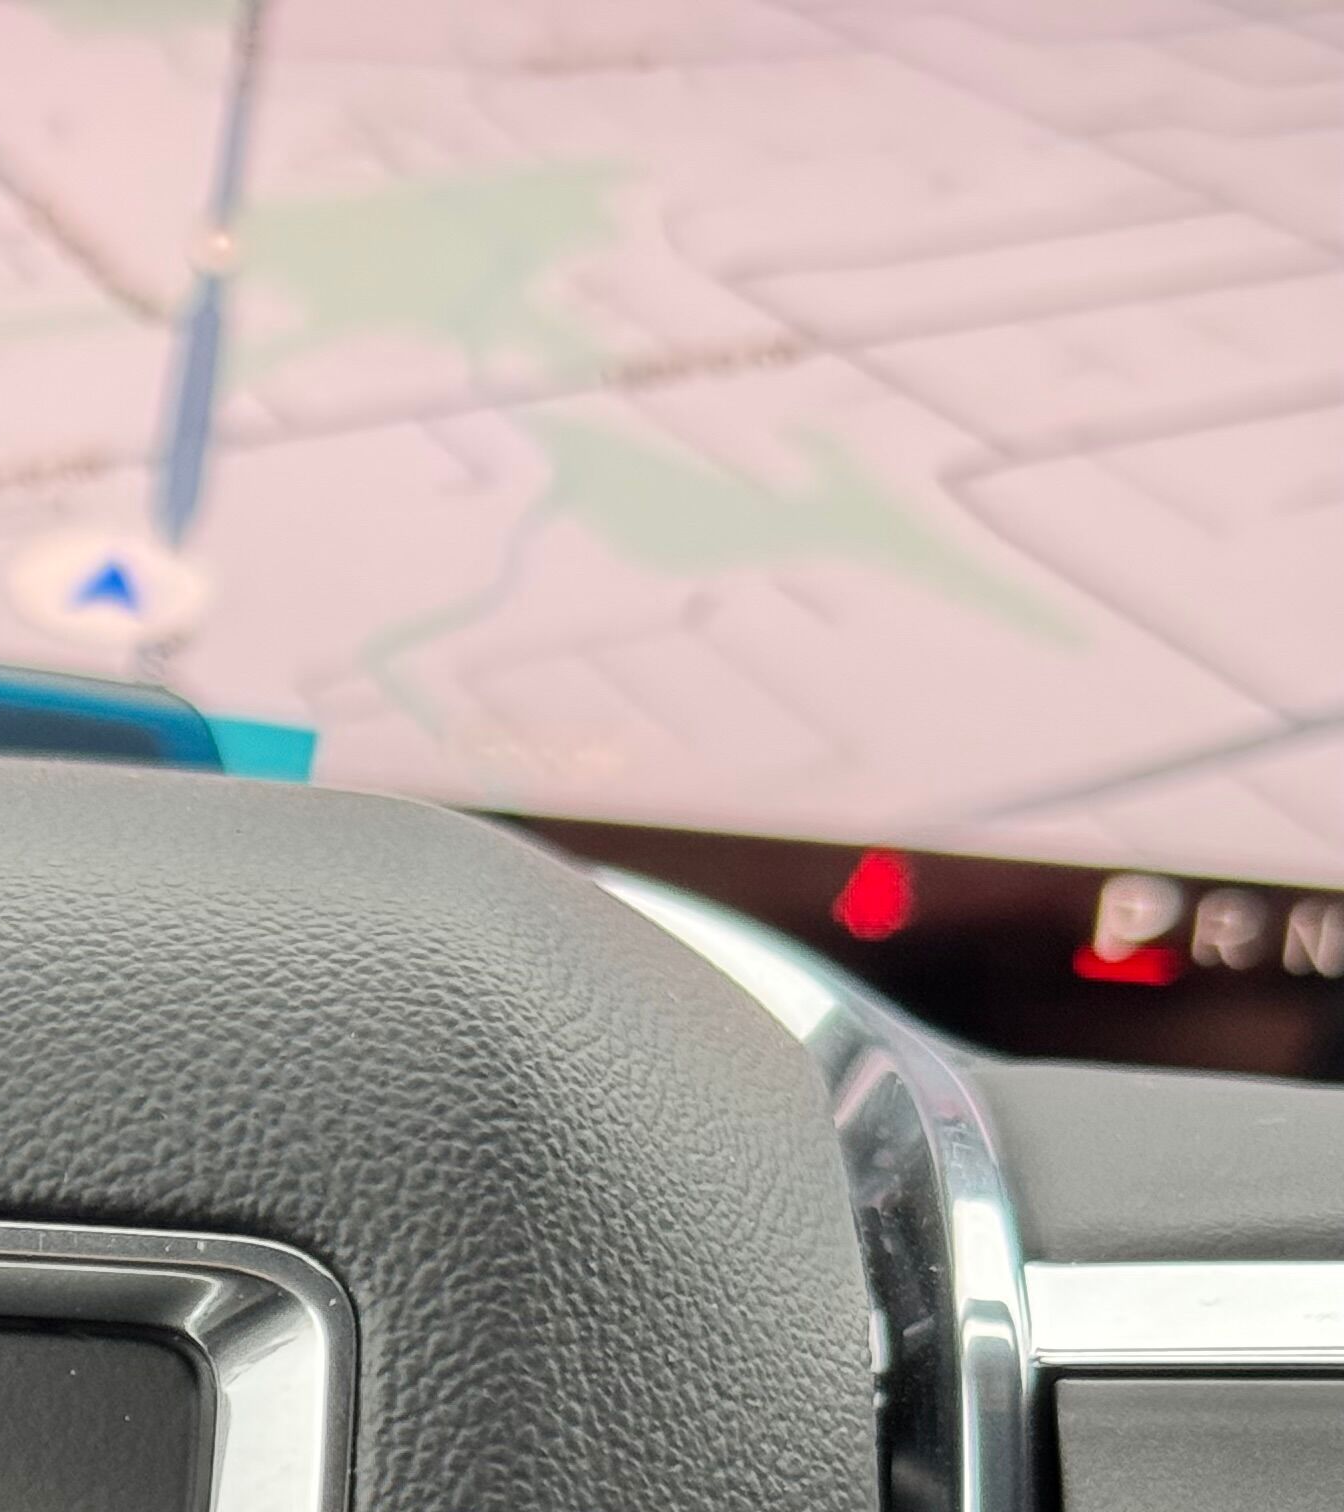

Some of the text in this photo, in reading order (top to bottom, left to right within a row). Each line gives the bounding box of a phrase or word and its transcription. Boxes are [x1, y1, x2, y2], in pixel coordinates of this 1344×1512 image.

[1094, 872, 1344, 978] P R N
